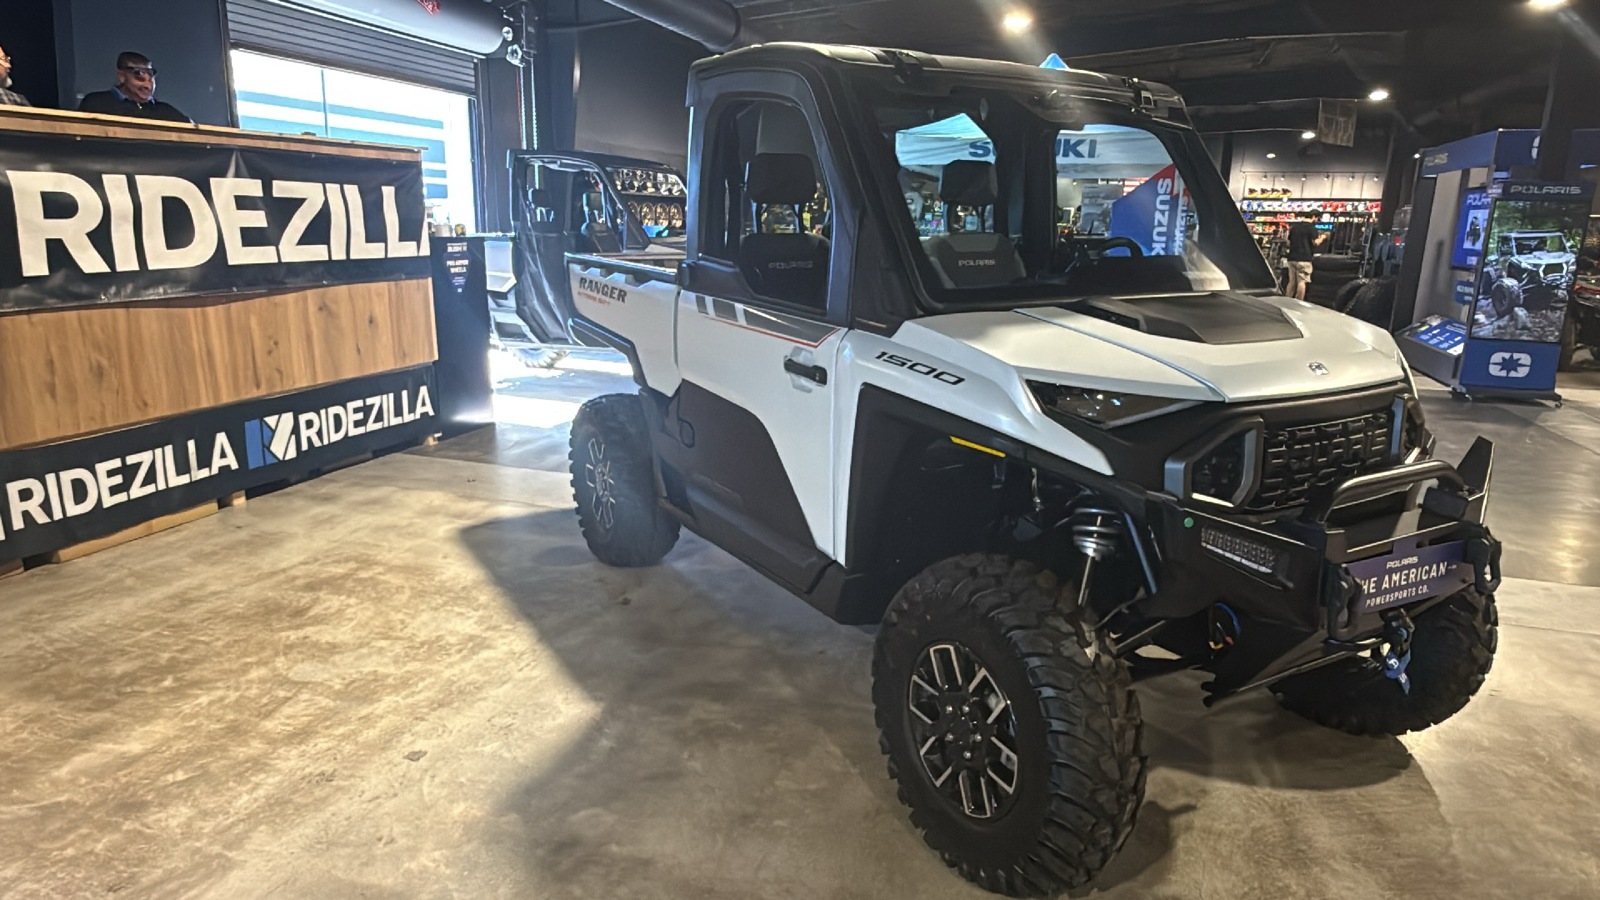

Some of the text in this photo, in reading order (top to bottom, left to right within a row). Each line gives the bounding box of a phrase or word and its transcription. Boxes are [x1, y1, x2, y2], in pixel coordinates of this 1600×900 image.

[1510, 185, 1582, 195] POLARIS
[1151, 178, 1173, 256] SUZUK
[768, 260, 814, 269] POLARIS
[958, 259, 996, 267] POLARIS
[579, 276, 628, 304] RANGER
[875, 351, 966, 386] 1500
[298, 385, 436, 452] RIDEZILLA
[6, 431, 239, 531] RIDEZILLA
[1386, 555, 1419, 570] POLARIS
[1361, 561, 1448, 595] HE AMERICAN
[1365, 584, 1430, 608] POWERSPORTS CO.
